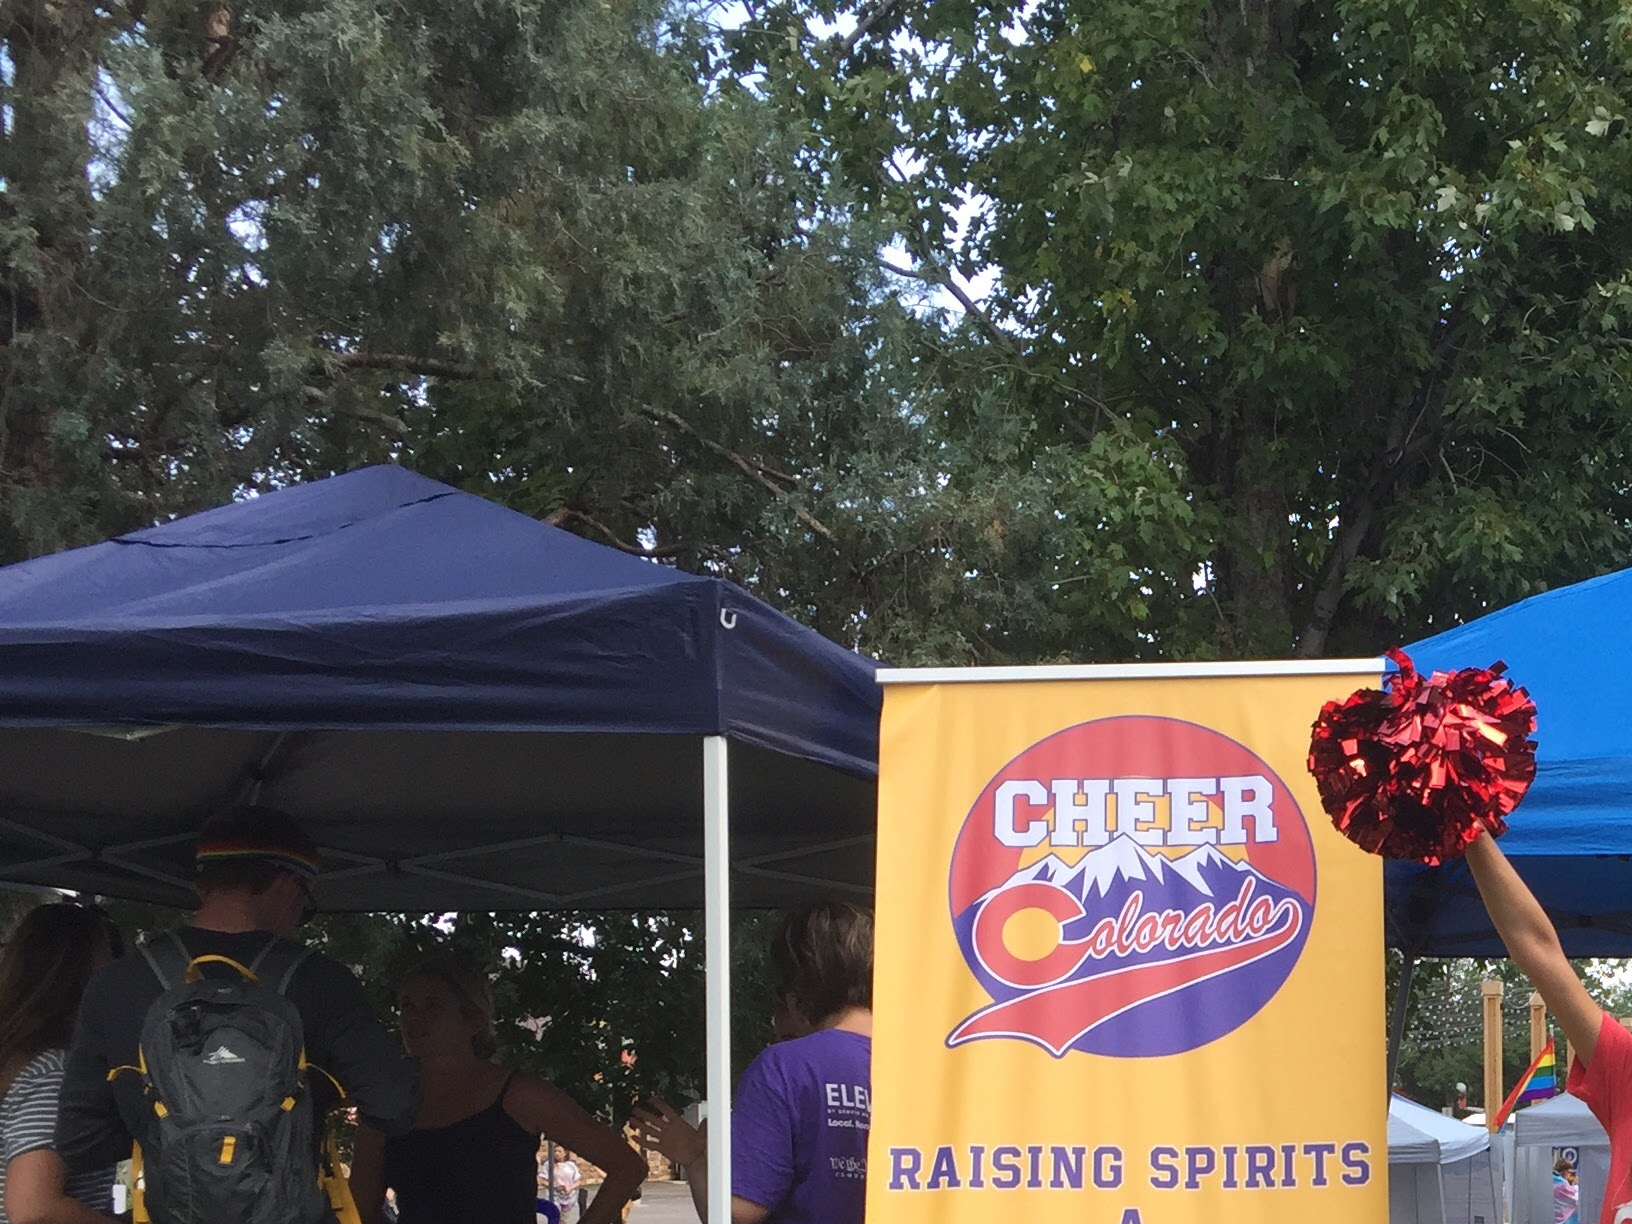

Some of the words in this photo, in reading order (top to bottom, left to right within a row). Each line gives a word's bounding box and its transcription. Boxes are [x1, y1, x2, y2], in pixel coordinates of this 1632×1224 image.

[994, 775, 1278, 848] CHEER
[973, 875, 1302, 990] Colorado
[888, 1144, 1125, 1191] RAISING
[1149, 1140, 1373, 1190] SPIRITS
